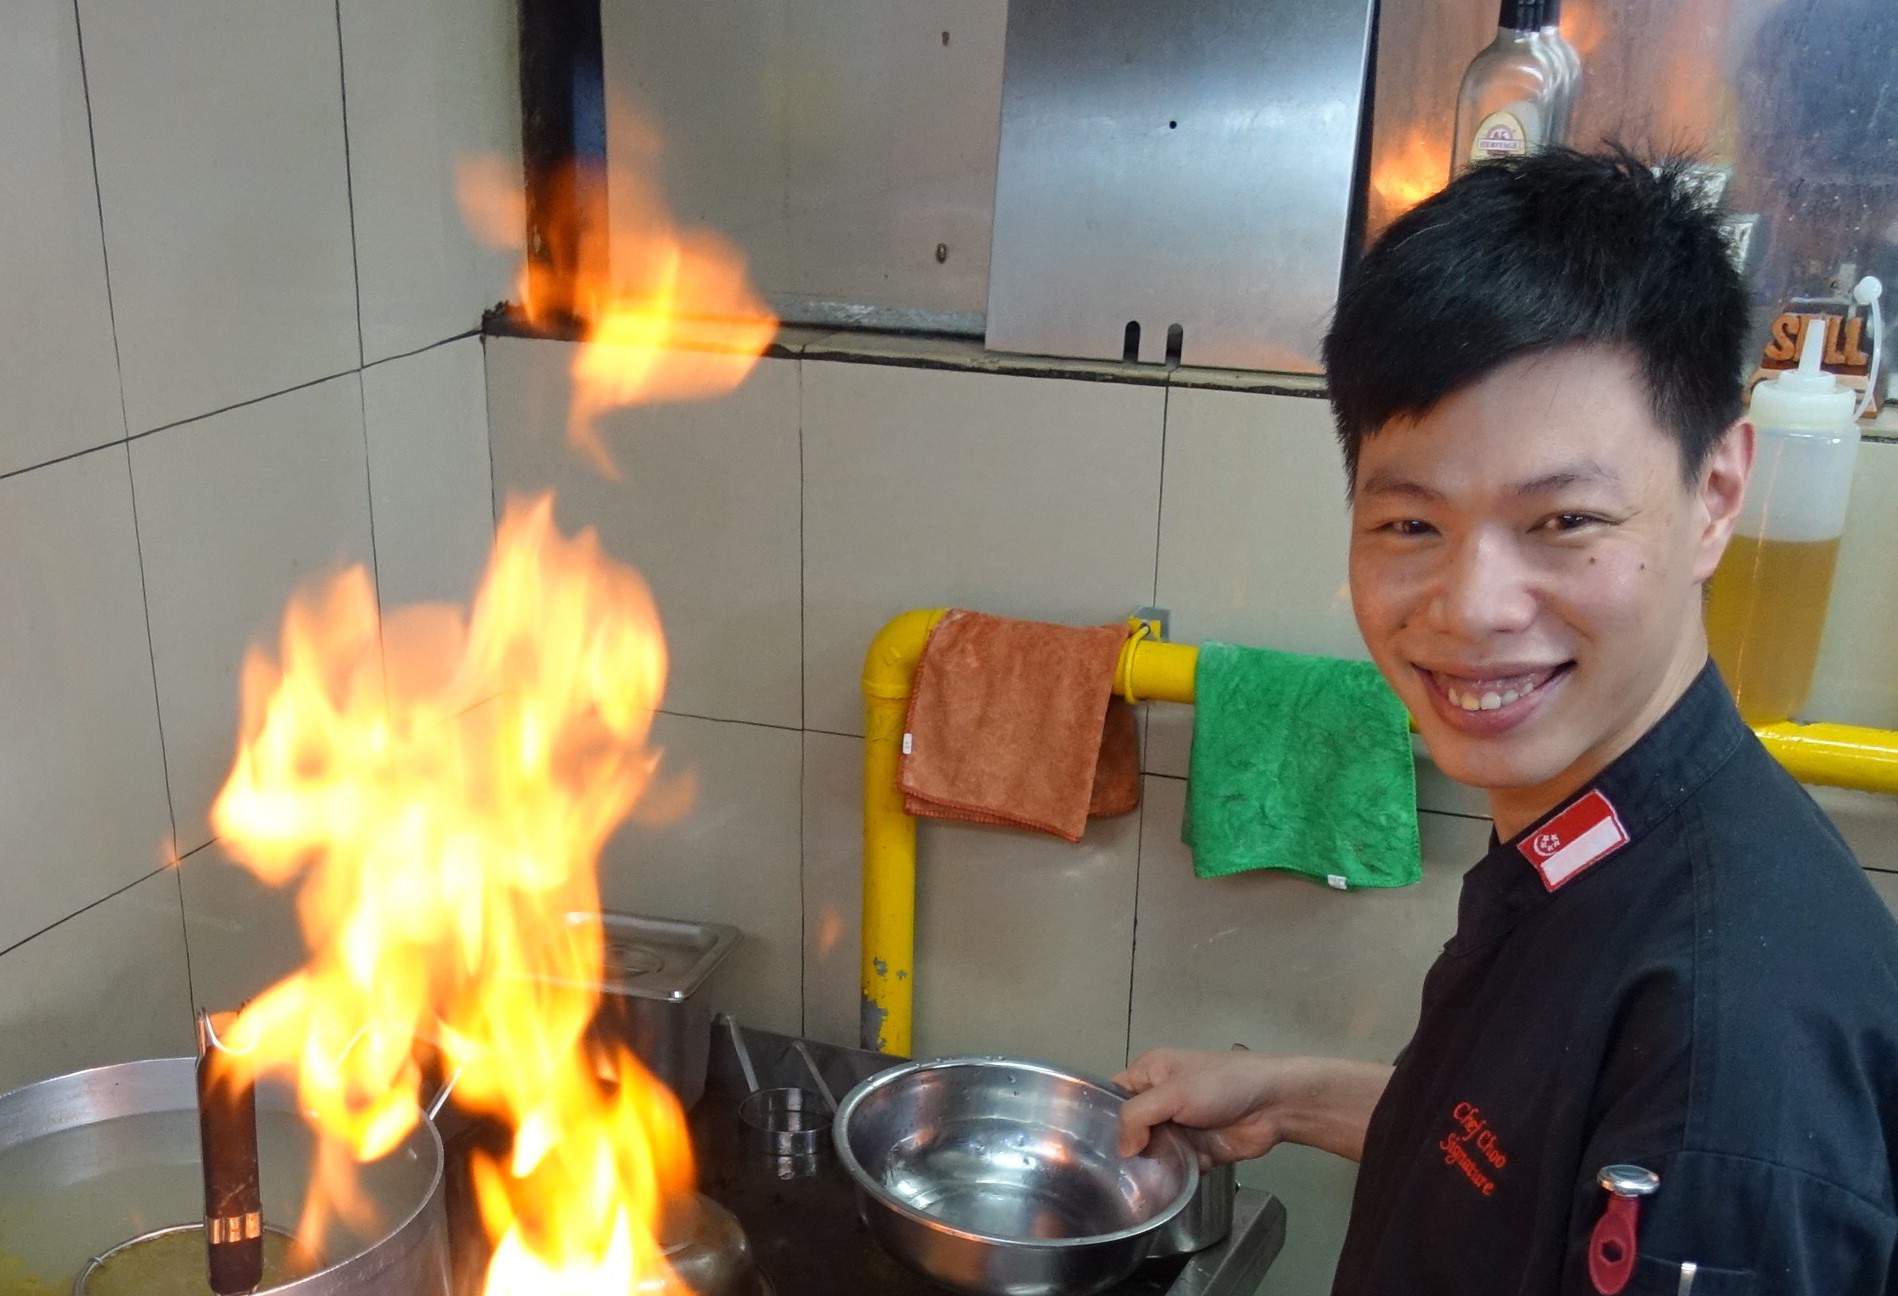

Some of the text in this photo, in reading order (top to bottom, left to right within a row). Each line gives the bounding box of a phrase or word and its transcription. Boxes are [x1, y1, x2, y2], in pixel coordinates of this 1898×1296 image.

[1440, 1132, 1494, 1195] Signature
[1453, 1102, 1506, 1168] Chef Choo
